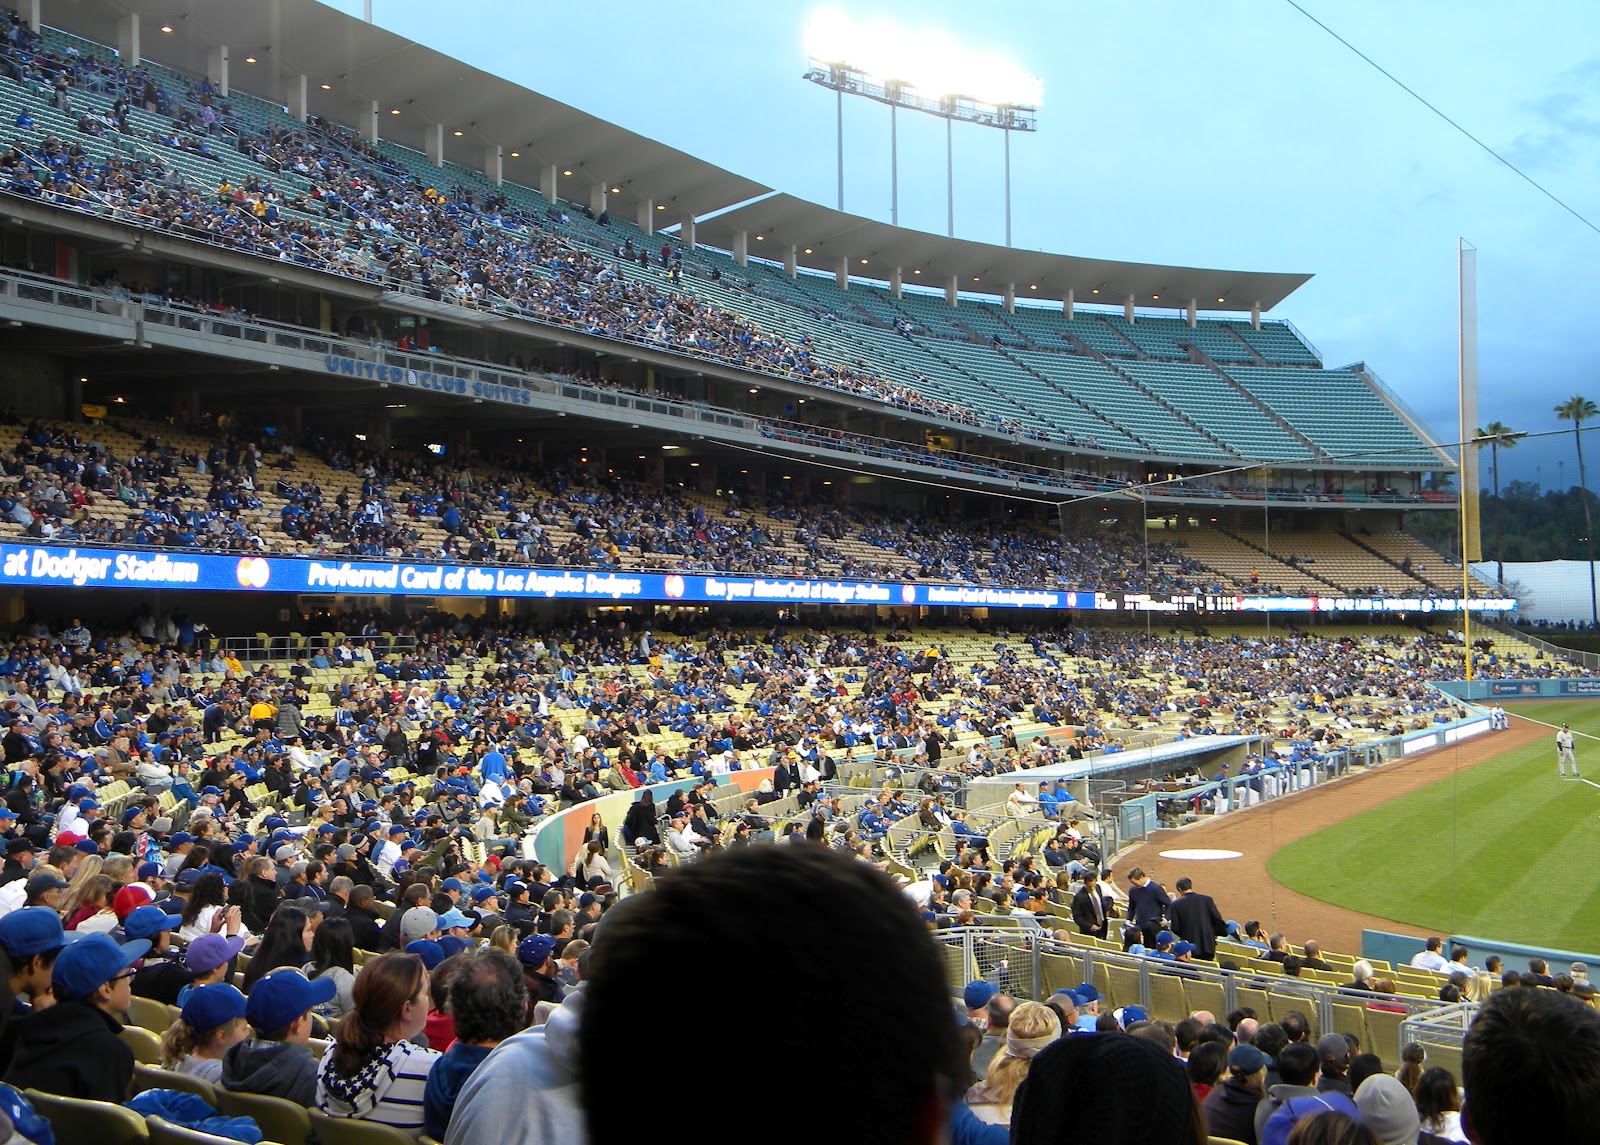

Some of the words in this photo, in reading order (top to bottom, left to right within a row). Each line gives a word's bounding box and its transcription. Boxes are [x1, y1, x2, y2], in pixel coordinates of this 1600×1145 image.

[326, 355, 403, 382] UNITED
[420, 371, 466, 394] CLUB
[473, 381, 531, 404] SUITES
[3, 549, 28, 576] at
[31, 549, 111, 586] Dodger
[114, 553, 199, 582] Stadium
[308, 562, 398, 589] Preferred
[401, 567, 444, 589] Card
[445, 568, 465, 590] of
[467, 568, 495, 591] the
[497, 570, 523, 591] Los
[524, 571, 584, 597] Angeles
[585, 573, 641, 598] Dodgers
